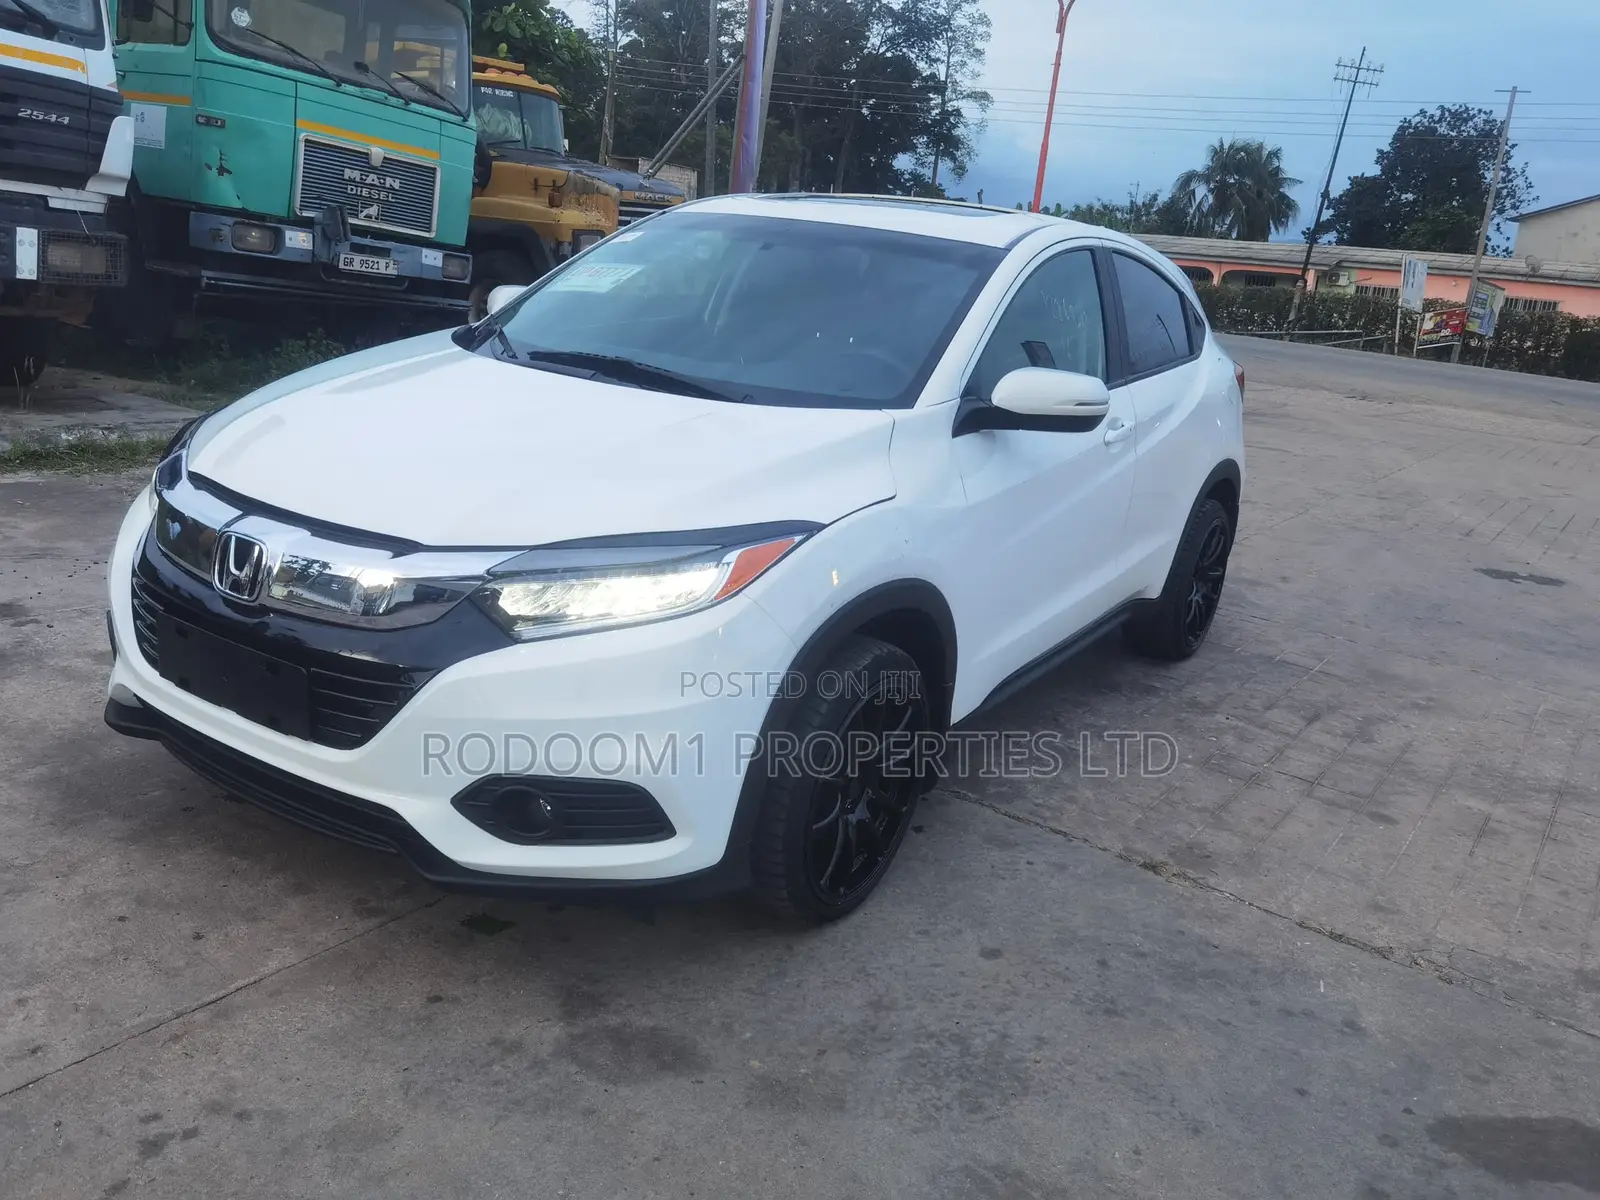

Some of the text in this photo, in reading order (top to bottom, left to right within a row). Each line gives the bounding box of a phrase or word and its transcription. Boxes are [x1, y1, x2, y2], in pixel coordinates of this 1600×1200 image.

[17, 108, 70, 125] 2544
[347, 185, 396, 202] DIESEL
[634, 191, 673, 203] MACK
[343, 256, 355, 268] GR
[359, 258, 381, 271] 9521
